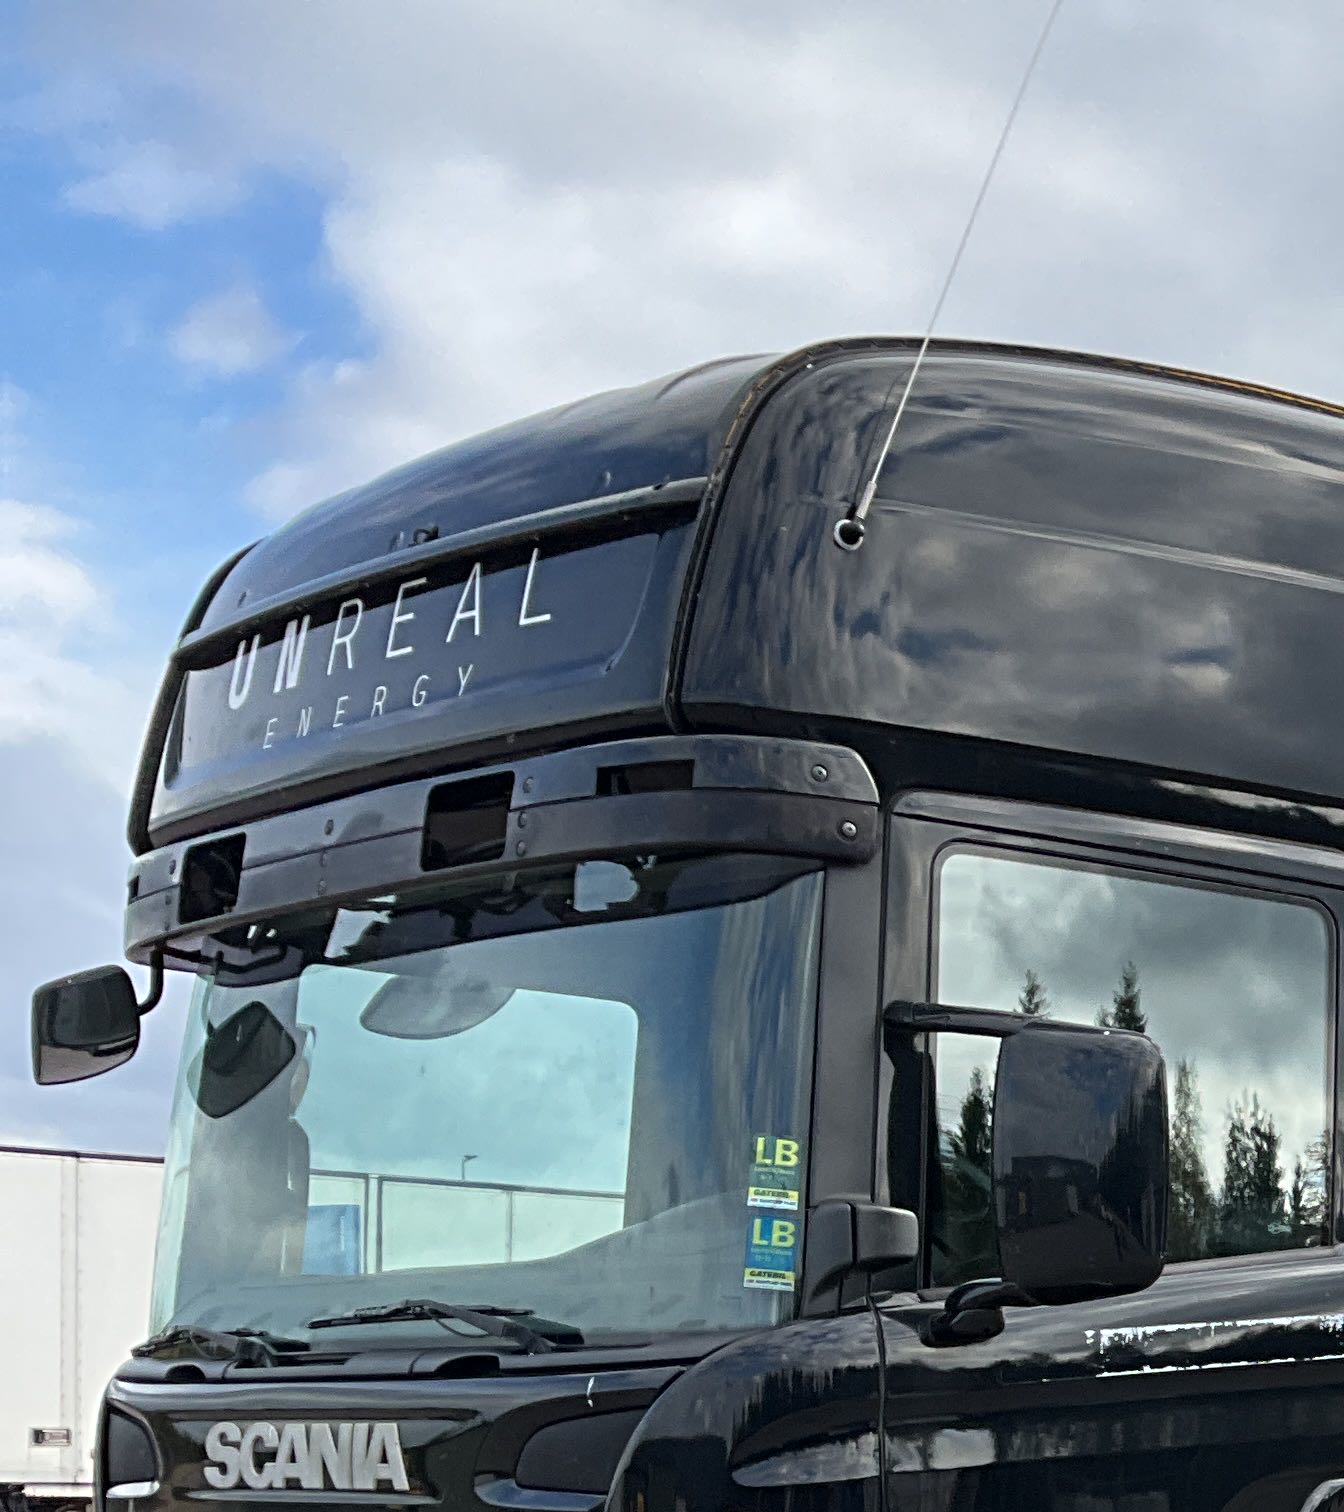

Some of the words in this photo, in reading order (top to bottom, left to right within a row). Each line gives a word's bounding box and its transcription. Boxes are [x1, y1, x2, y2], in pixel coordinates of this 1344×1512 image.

[228, 548, 551, 710] UNREAL
[262, 664, 474, 750] ENERGY
[755, 1136, 799, 1168] LB
[751, 1217, 796, 1249] LB
[203, 1421, 411, 1492] SCANIA
